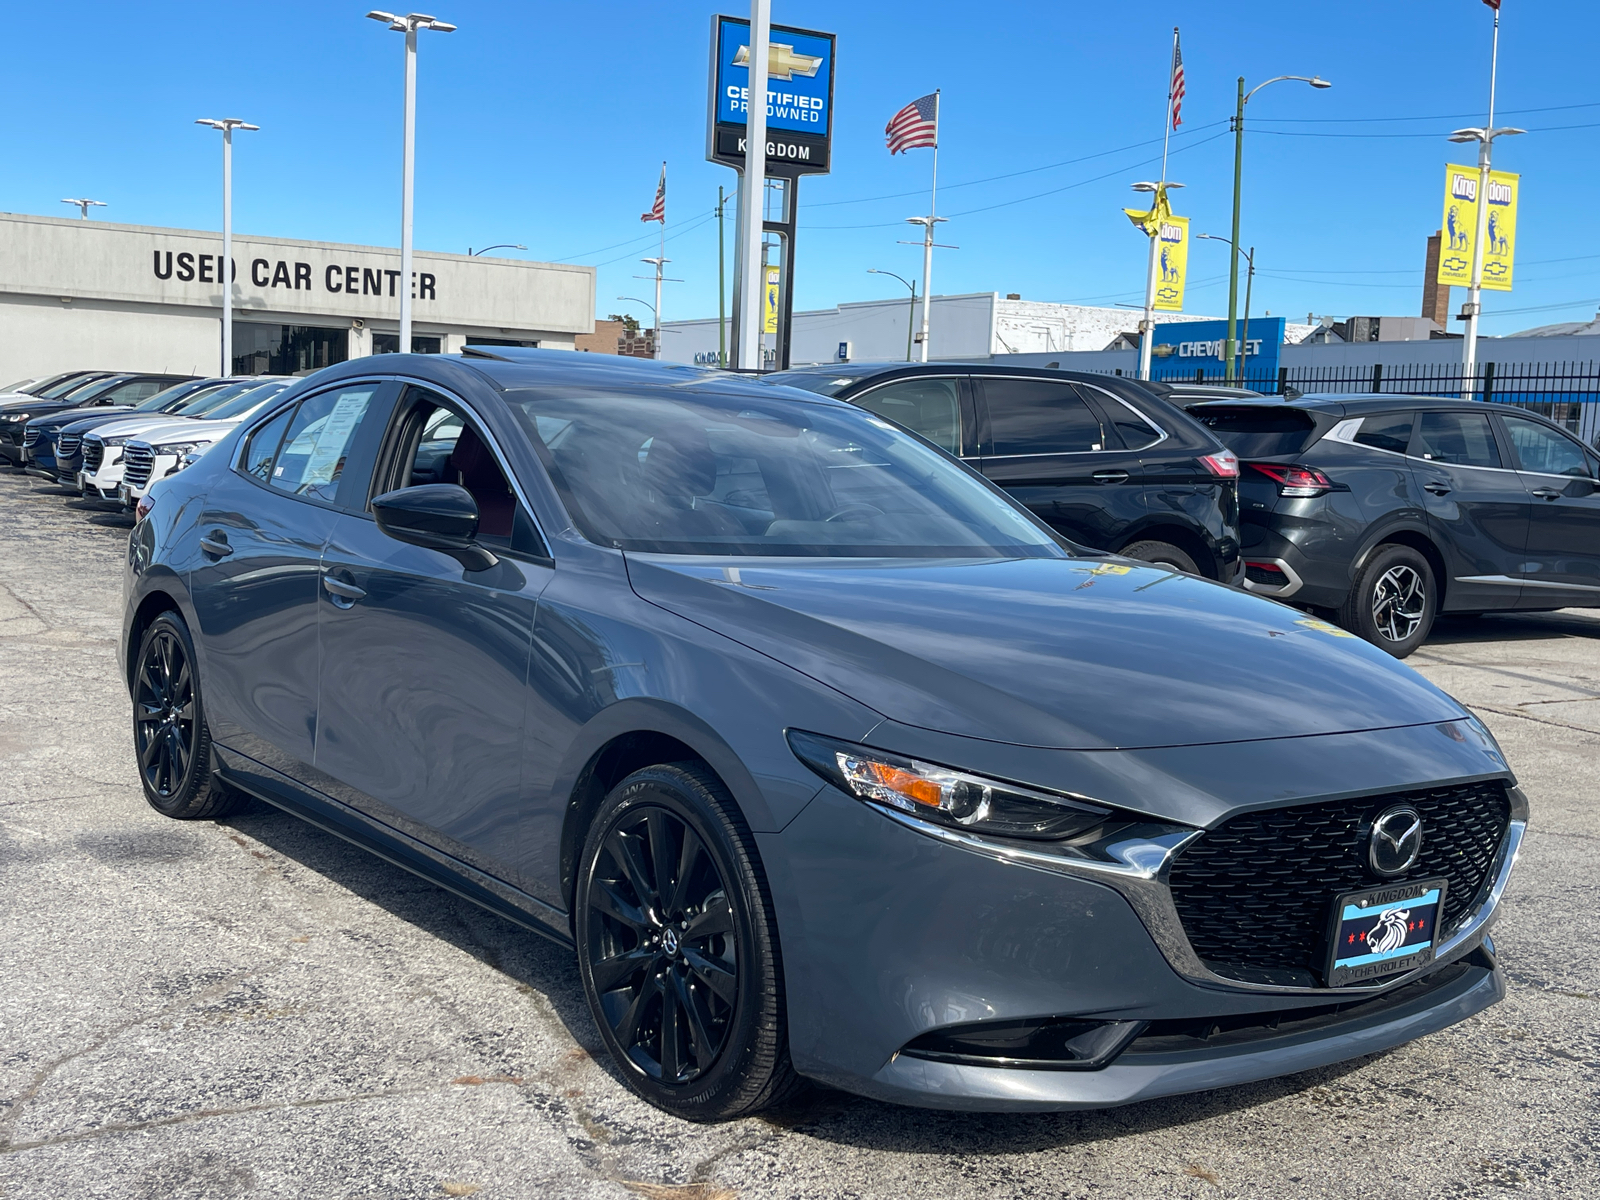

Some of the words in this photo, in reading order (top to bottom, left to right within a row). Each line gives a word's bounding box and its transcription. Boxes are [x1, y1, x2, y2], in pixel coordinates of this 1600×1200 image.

[727, 86, 823, 110] CETIFIED
[738, 138, 810, 160] KGDOM
[1452, 174, 1477, 203] King
[1488, 180, 1512, 206] dom
[1161, 222, 1182, 243] dom
[153, 250, 237, 284] USED
[251, 258, 312, 291] CAR
[1179, 339, 1263, 357] CHEVRLET
[1367, 885, 1423, 905] KINGDOM
[1354, 956, 1412, 978] CHEVROLET
